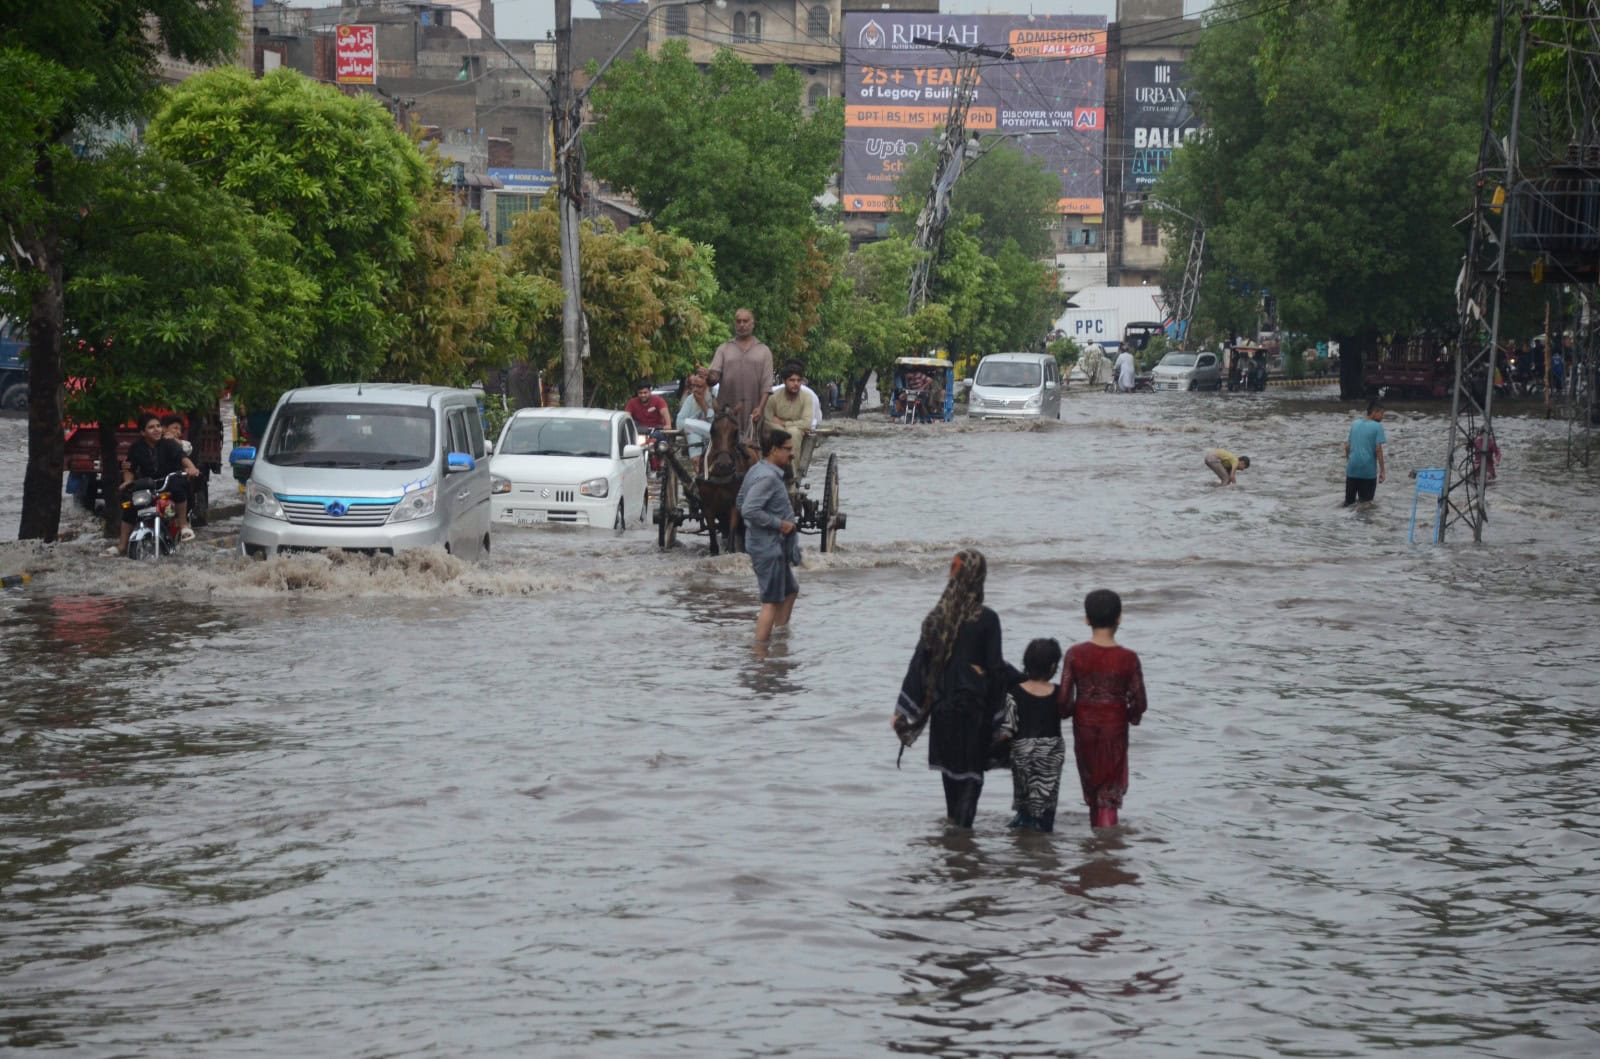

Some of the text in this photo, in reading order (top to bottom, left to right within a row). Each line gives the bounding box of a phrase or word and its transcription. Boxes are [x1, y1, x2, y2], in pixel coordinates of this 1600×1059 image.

[892, 24, 979, 44] RIPHAH
[1016, 32, 1095, 43] ADMISSIONS
[1016, 45, 1096, 55] OPEN FALL 2024
[862, 66, 905, 85] 25+
[861, 86, 979, 101] of Legacy Builg
[1135, 87, 1187, 104] URBAN
[887, 111, 901, 121] BS
[909, 112, 925, 122] MS
[970, 111, 992, 123] PhD
[1052, 119, 1074, 127] WITH
[1076, 110, 1097, 127] AI
[1075, 319, 1104, 334] PPC
